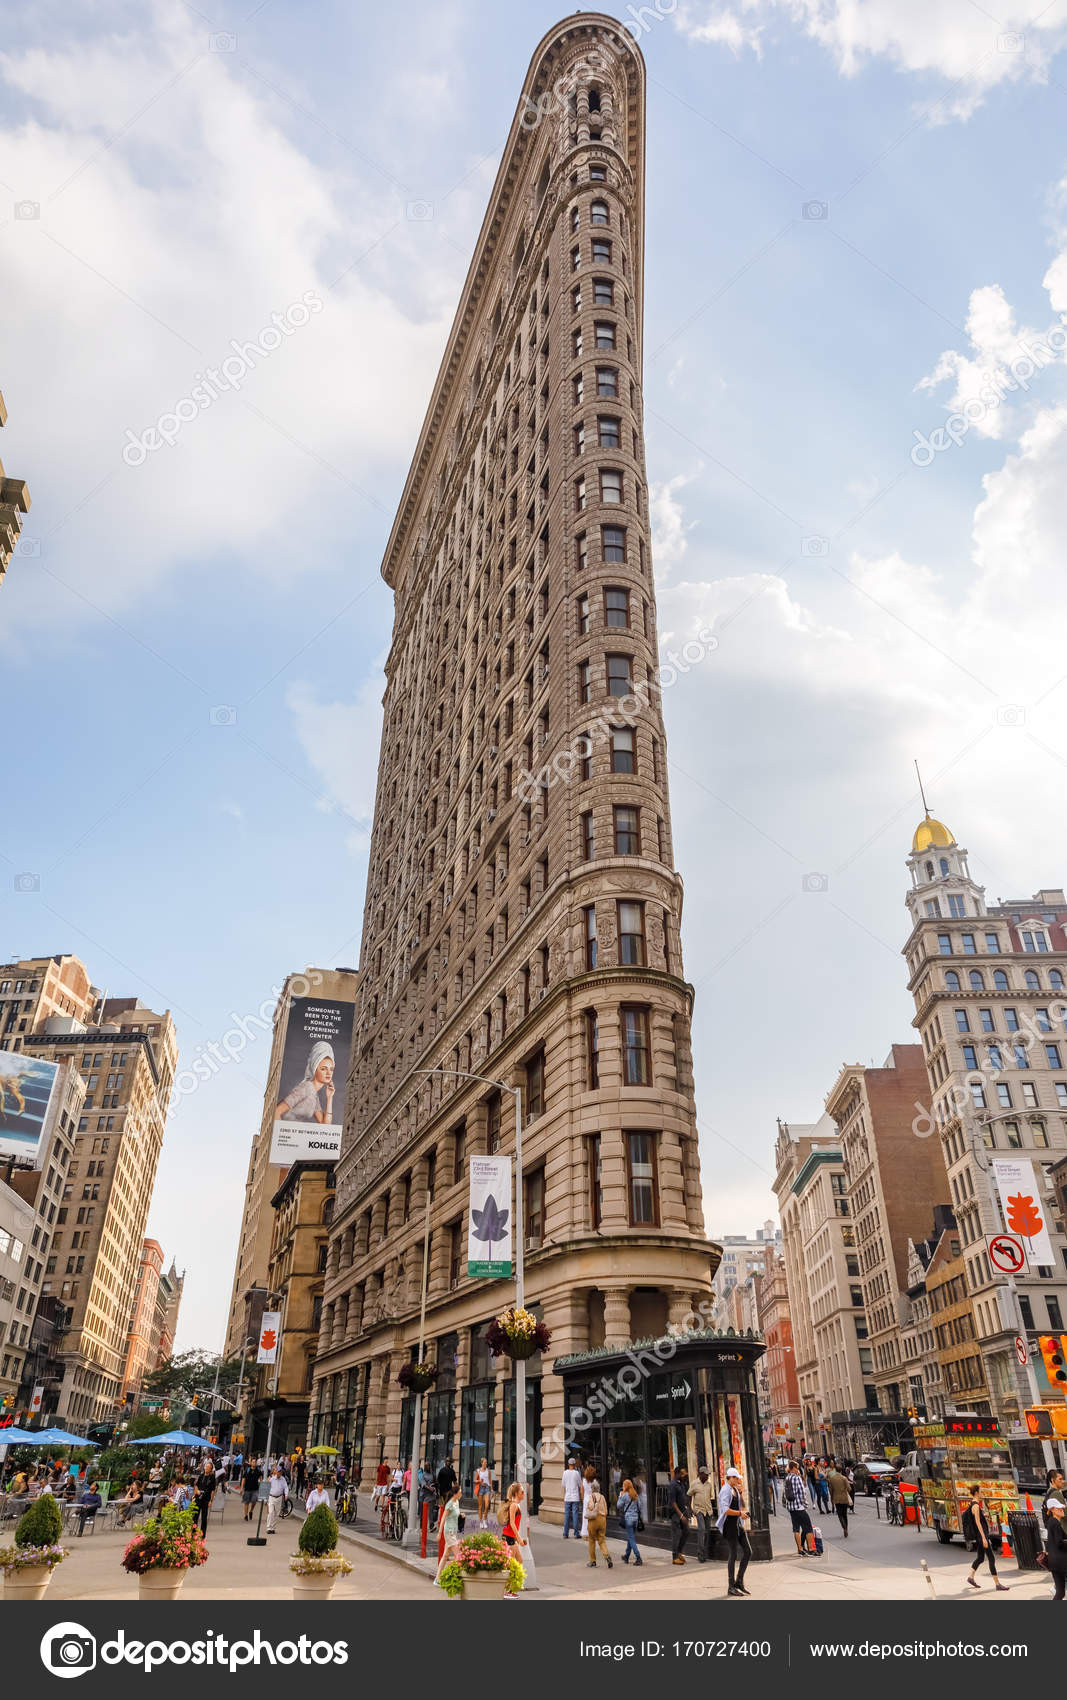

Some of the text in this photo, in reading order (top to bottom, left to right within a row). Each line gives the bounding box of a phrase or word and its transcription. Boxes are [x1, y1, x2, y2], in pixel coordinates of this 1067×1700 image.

[307, 1006, 340, 1015] SOMEONE'S
[303, 1025, 339, 1034] EXPERIENCE
[309, 1032, 332, 1040] CENTER
[308, 1141, 339, 1151] KOHLER
[717, 1353, 736, 1362] Sprint
[671, 1386, 685, 1400] Sprint
